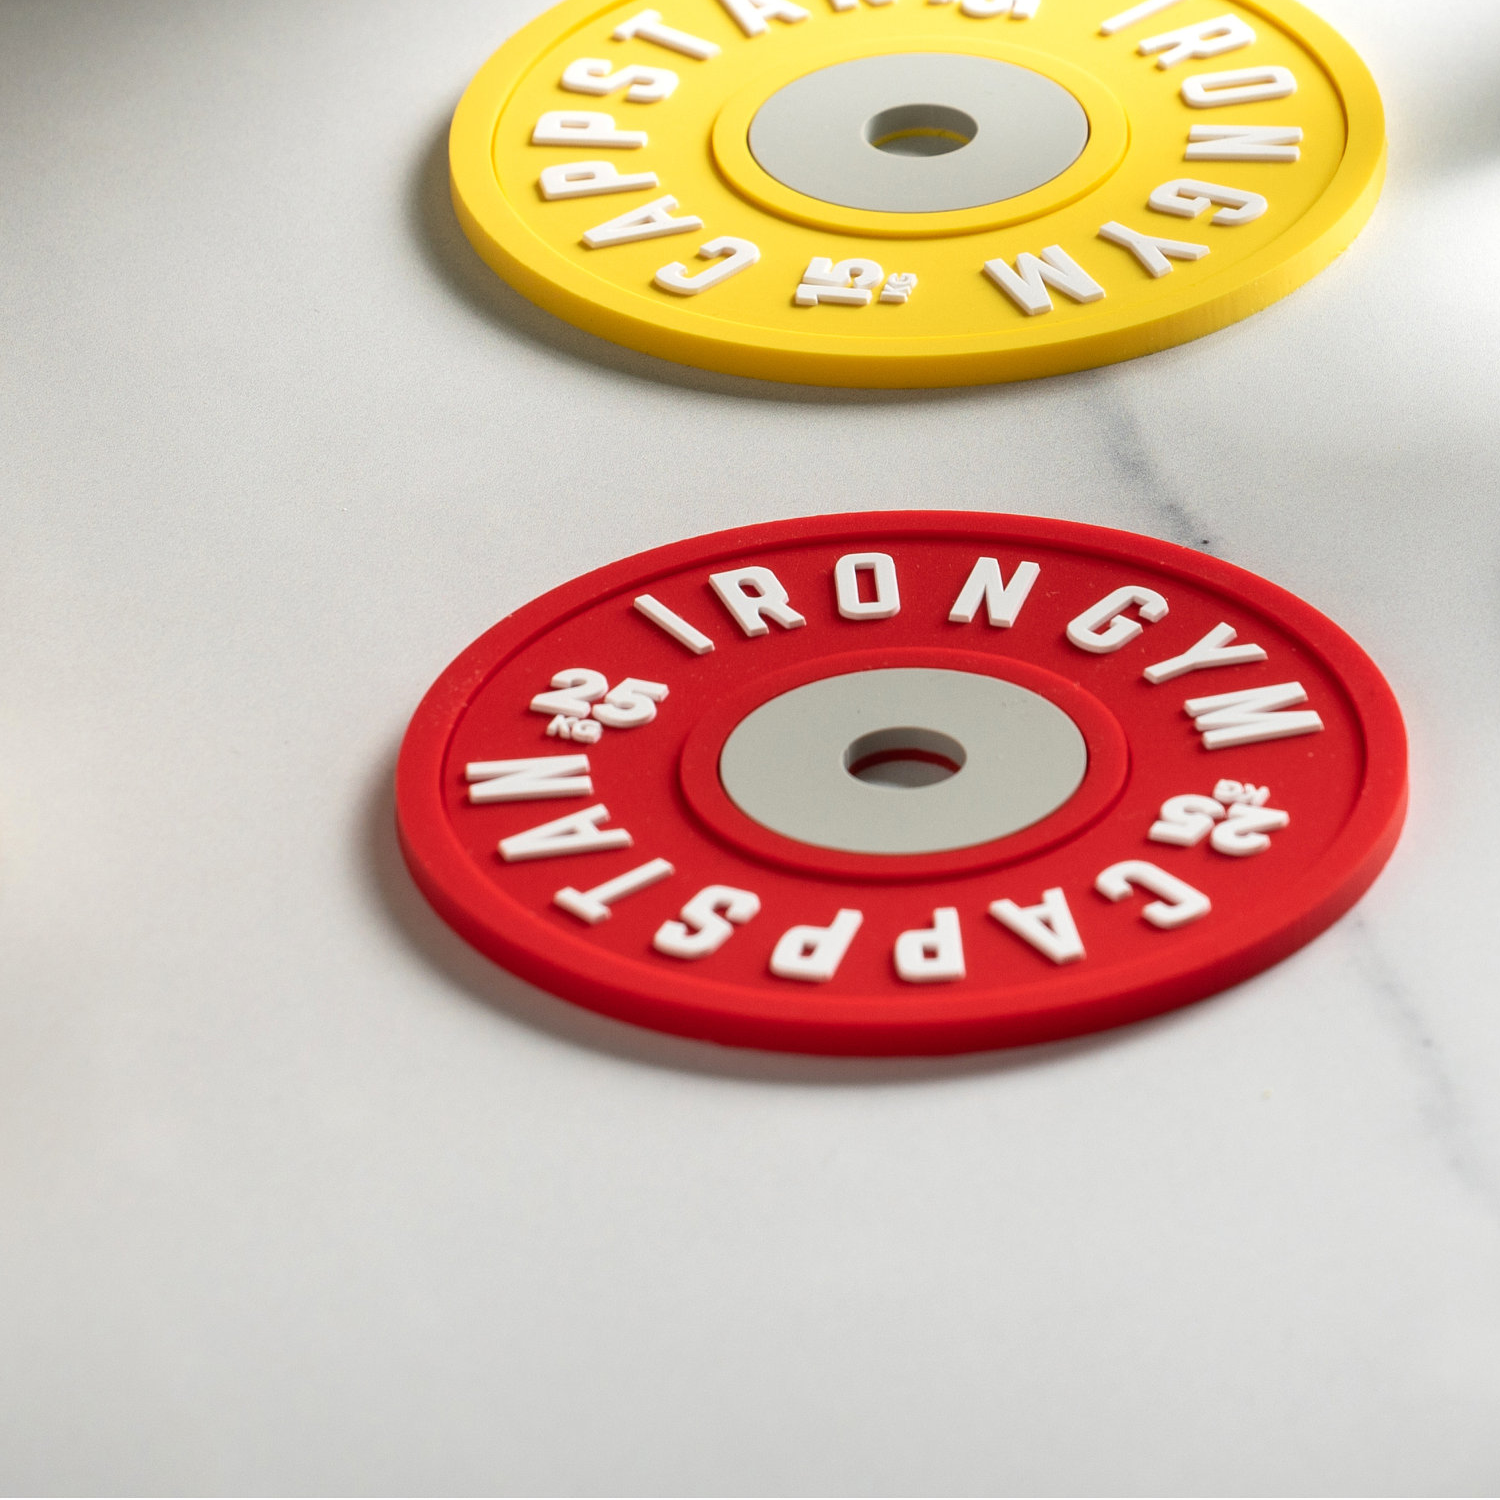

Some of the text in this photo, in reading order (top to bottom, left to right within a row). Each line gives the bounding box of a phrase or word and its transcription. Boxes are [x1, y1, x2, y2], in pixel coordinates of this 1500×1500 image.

[795, 256, 885, 306] 15
[529, 667, 670, 729] 25
[1147, 793, 1291, 858] 25
[464, 752, 1211, 985] CAPPSTAN
